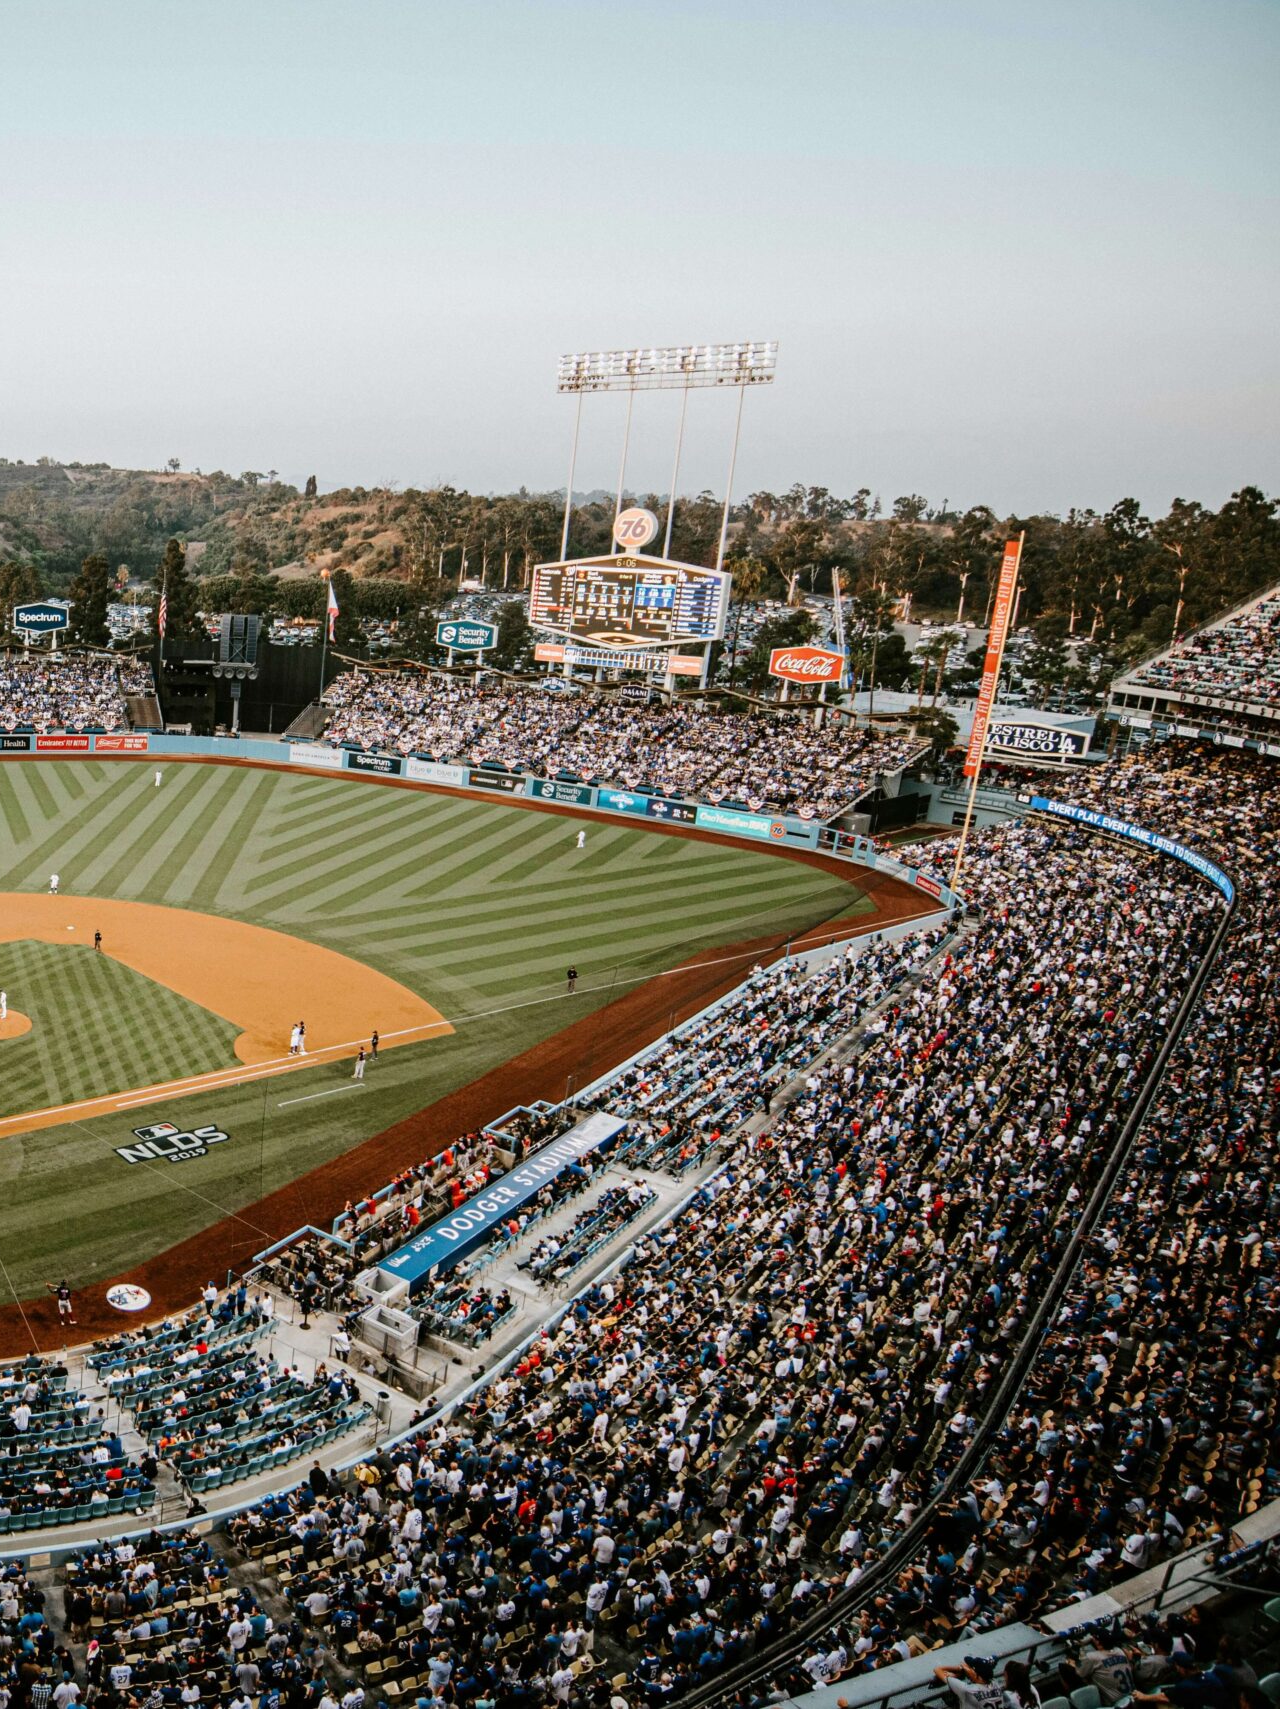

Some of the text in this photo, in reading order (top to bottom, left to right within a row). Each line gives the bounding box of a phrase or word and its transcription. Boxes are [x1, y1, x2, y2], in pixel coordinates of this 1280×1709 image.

[619, 517, 647, 539] 76
[988, 554, 1017, 655] Emirates FLY BETTER
[18, 612, 62, 624] Spectrum
[458, 626, 490, 639] Security
[458, 634, 487, 645] Benefit
[774, 653, 834, 678] Coca-Cola
[622, 687, 648, 697] DASANI
[1180, 692, 1248, 711] DODGER
[966, 670, 995, 767] Emirates FLY BETTER
[3, 739, 26, 747] Health
[356, 755, 390, 766] Spectrum
[410, 765, 426, 773] blue
[436, 767, 452, 776] blue
[556, 785, 582, 796] Security
[556, 792, 578, 801] Benefit
[772, 826, 783, 835] 76
[1047, 801, 1077, 816] EVERY
[1077, 809, 1101, 825] PLAY.
[1102, 817, 1130, 834] EVERY
[1129, 826, 1152, 843] GAME.
[1152, 835, 1176, 853] LISTEN
[1175, 845, 1184, 857] TO
[116, 1126, 229, 1163] NLDS
[168, 1147, 207, 1162] 2019
[437, 1136, 588, 1240] DODGER STADIUM
[1113, 1666, 1136, 1694] 31
